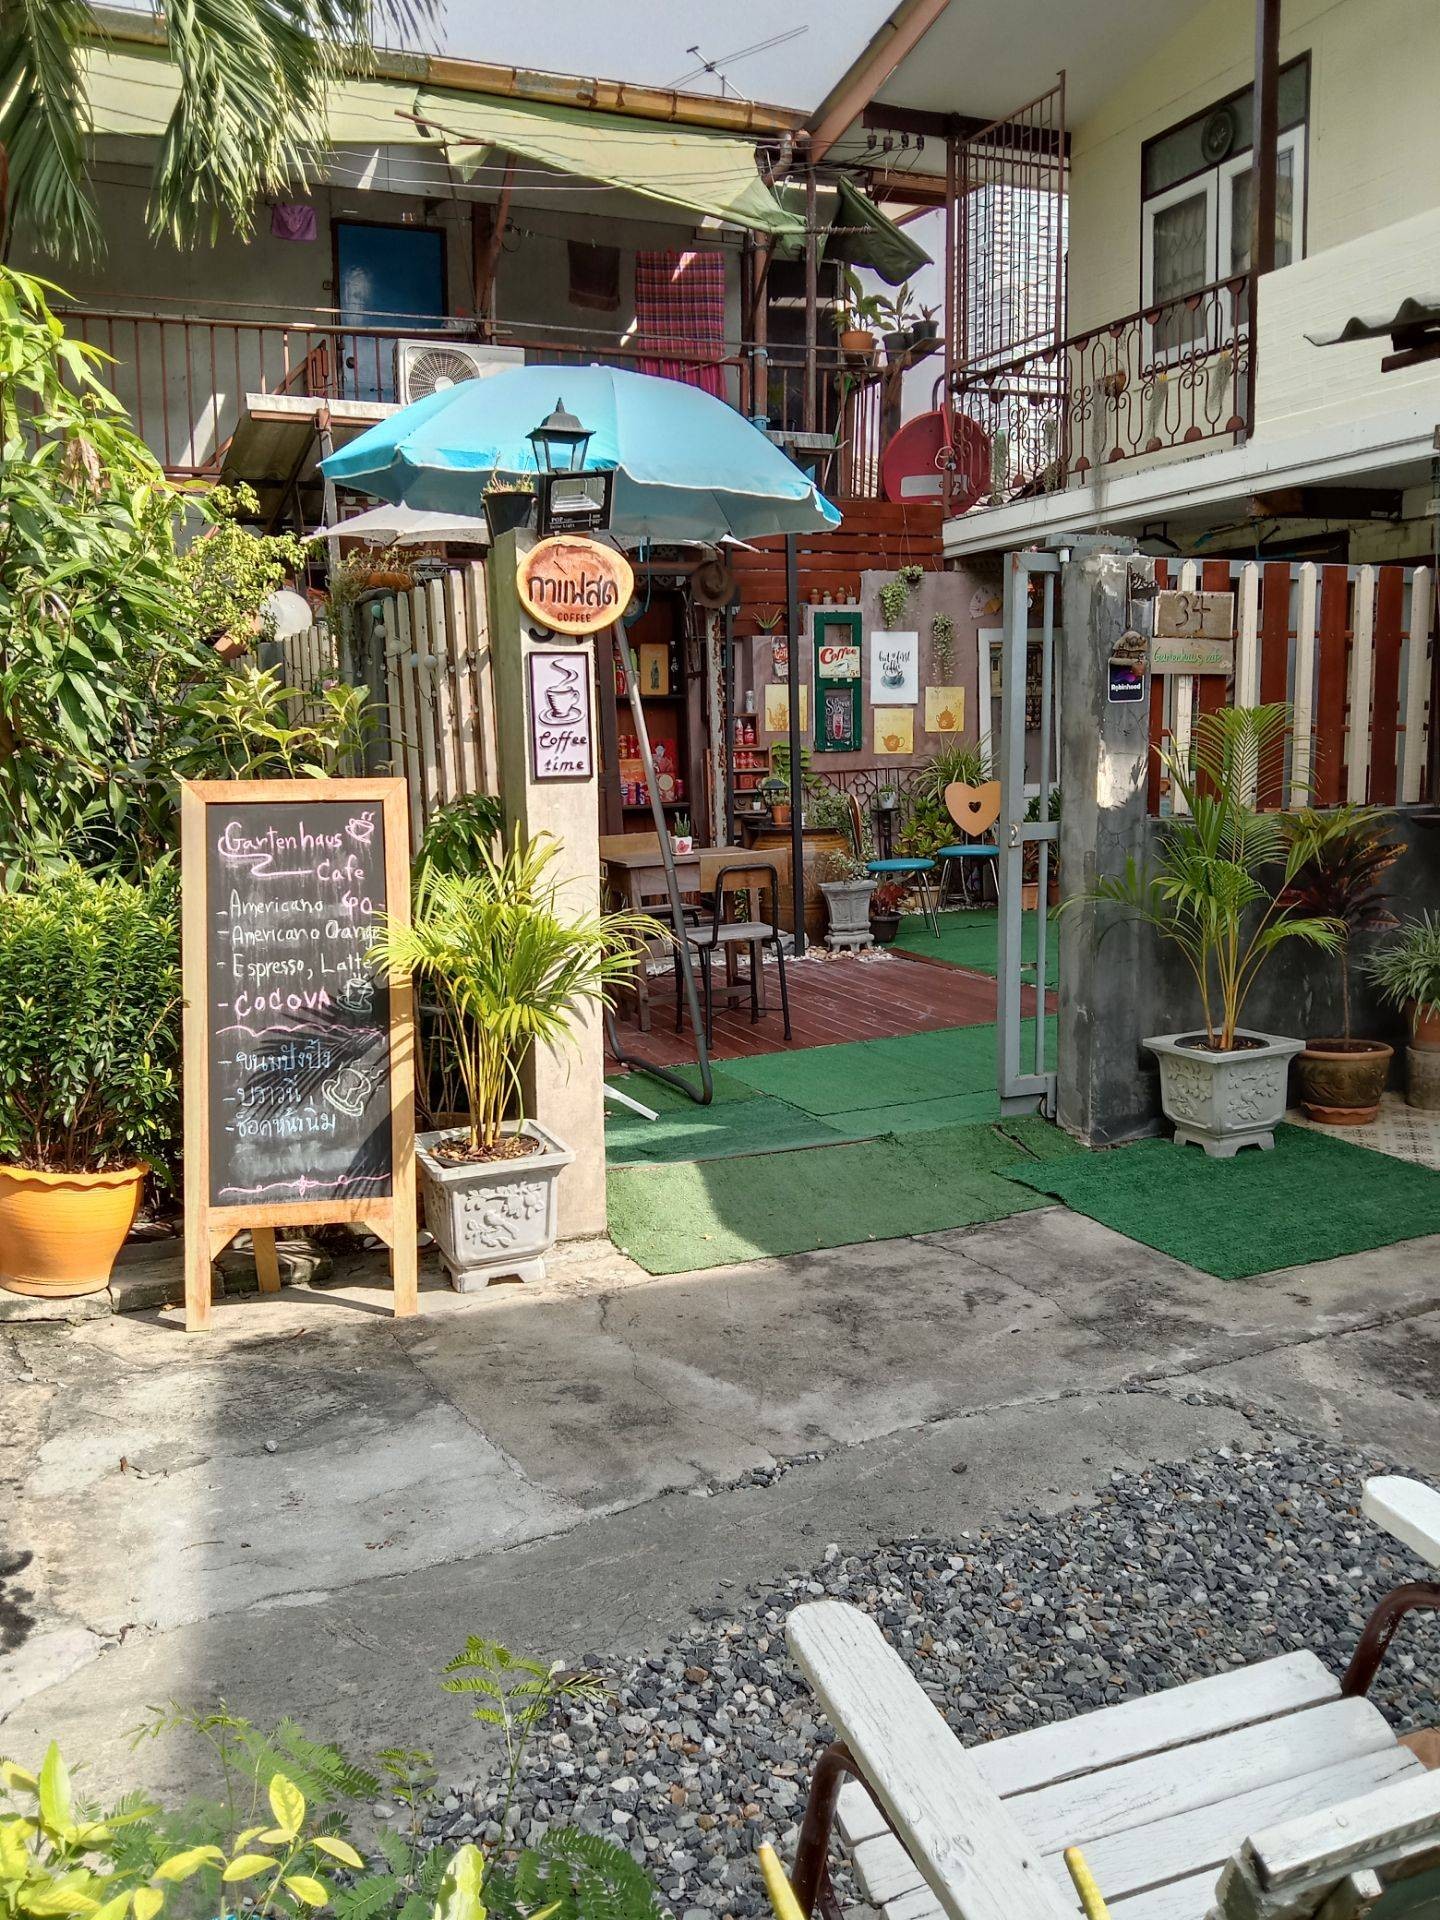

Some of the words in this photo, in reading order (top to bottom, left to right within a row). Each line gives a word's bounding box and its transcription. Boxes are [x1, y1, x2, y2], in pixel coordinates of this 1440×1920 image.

[527, 571, 619, 608] กาแฟสด
[557, 612, 592, 623] COFFEE
[1175, 594, 1211, 630] 34
[820, 647, 857, 665] Coffee
[1110, 683, 1141, 692] Robinhood
[539, 730, 588, 755] Coffee
[544, 755, 585, 771] time
[219, 821, 343, 854] Gartenhaus
[317, 854, 364, 882] Cafe
[230, 889, 324, 917] Americano
[232, 925, 320, 947] Americano
[321, 952, 373, 974] Latte
